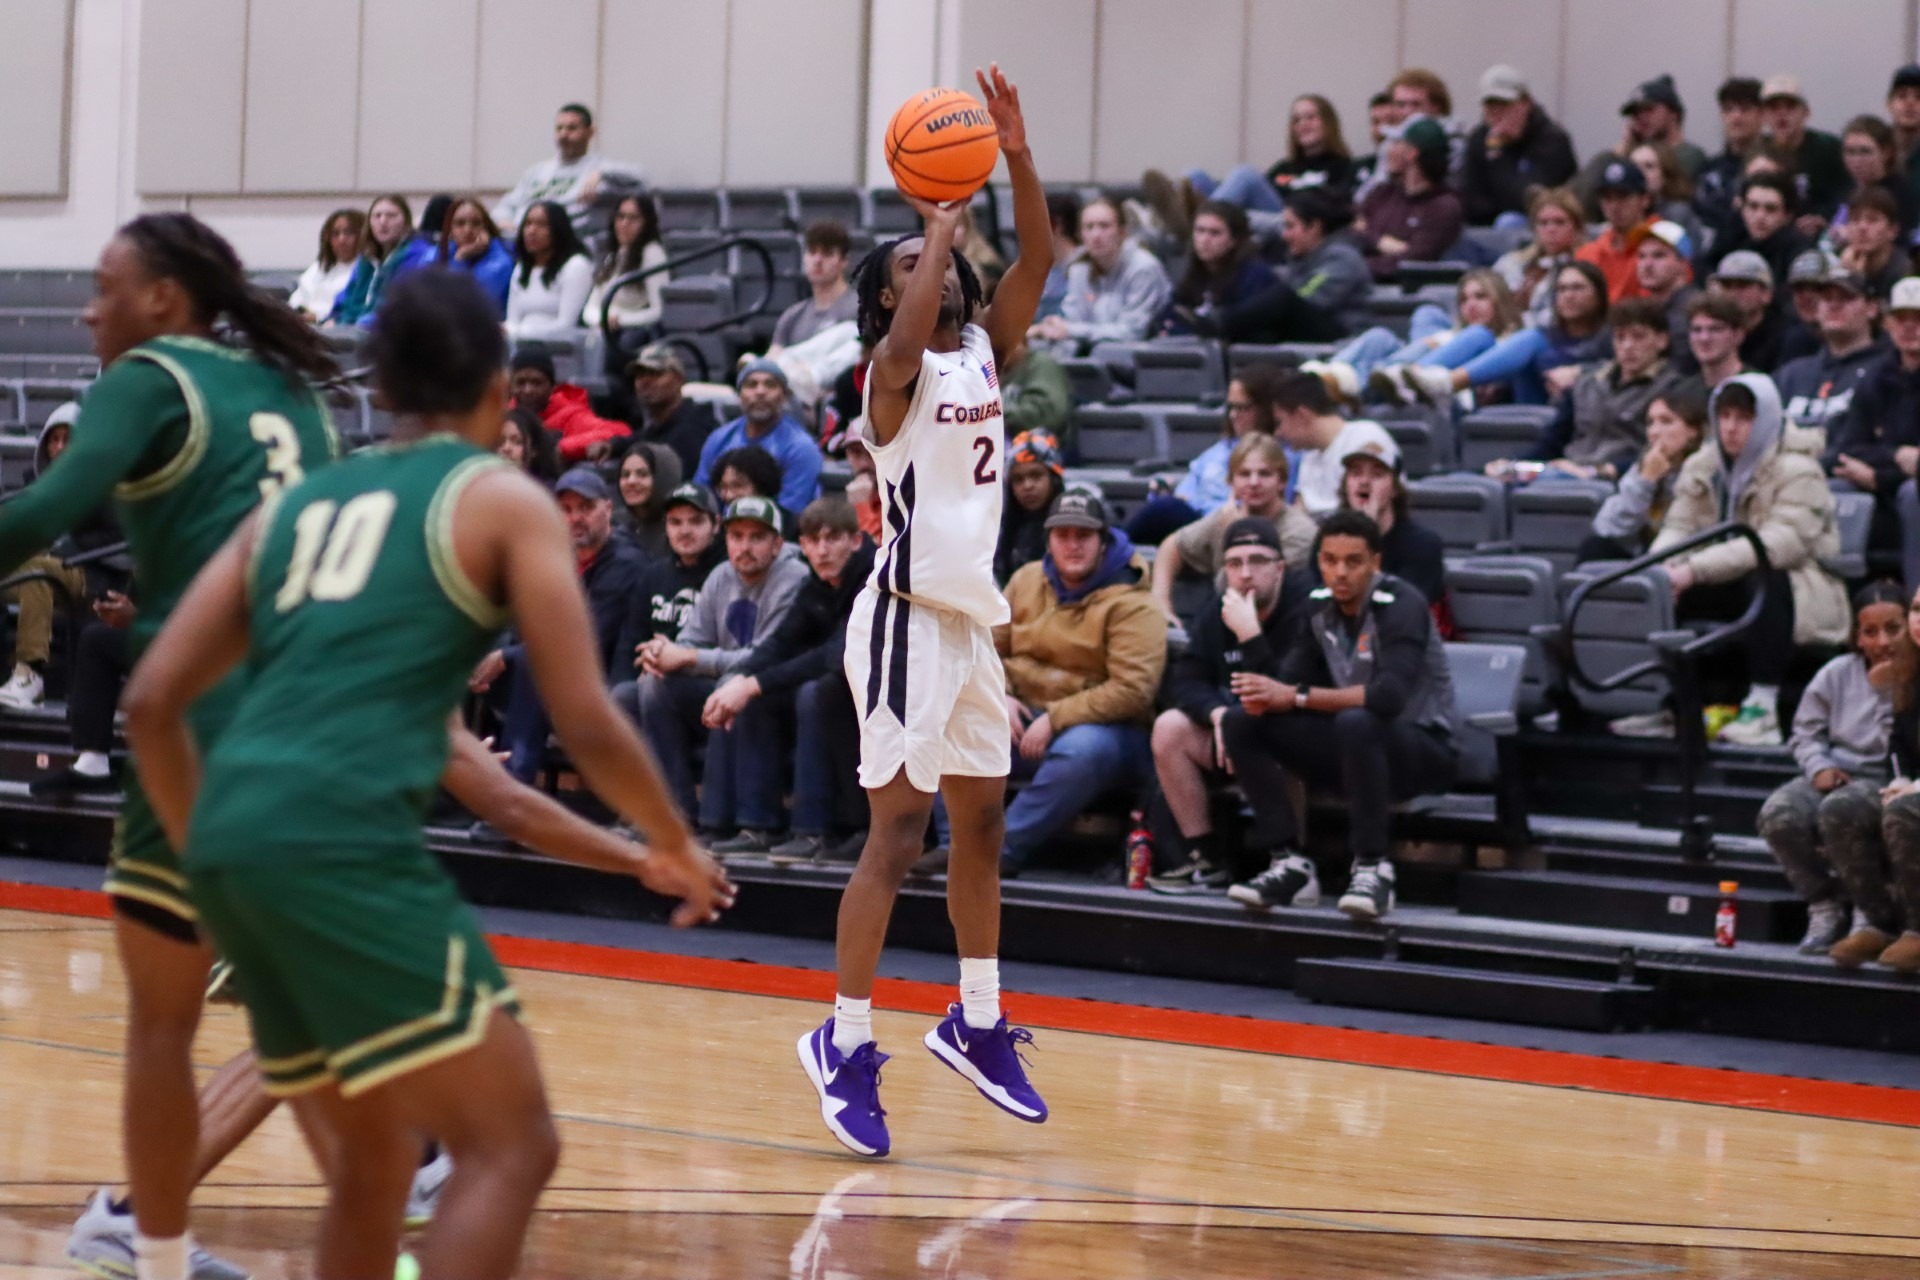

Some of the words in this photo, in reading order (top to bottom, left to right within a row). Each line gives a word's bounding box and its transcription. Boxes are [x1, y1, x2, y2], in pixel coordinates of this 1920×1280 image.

[926, 109, 993, 133] Wilson
[249, 413, 303, 498] 3
[973, 436, 996, 485] 2
[275, 490, 397, 613] 10
